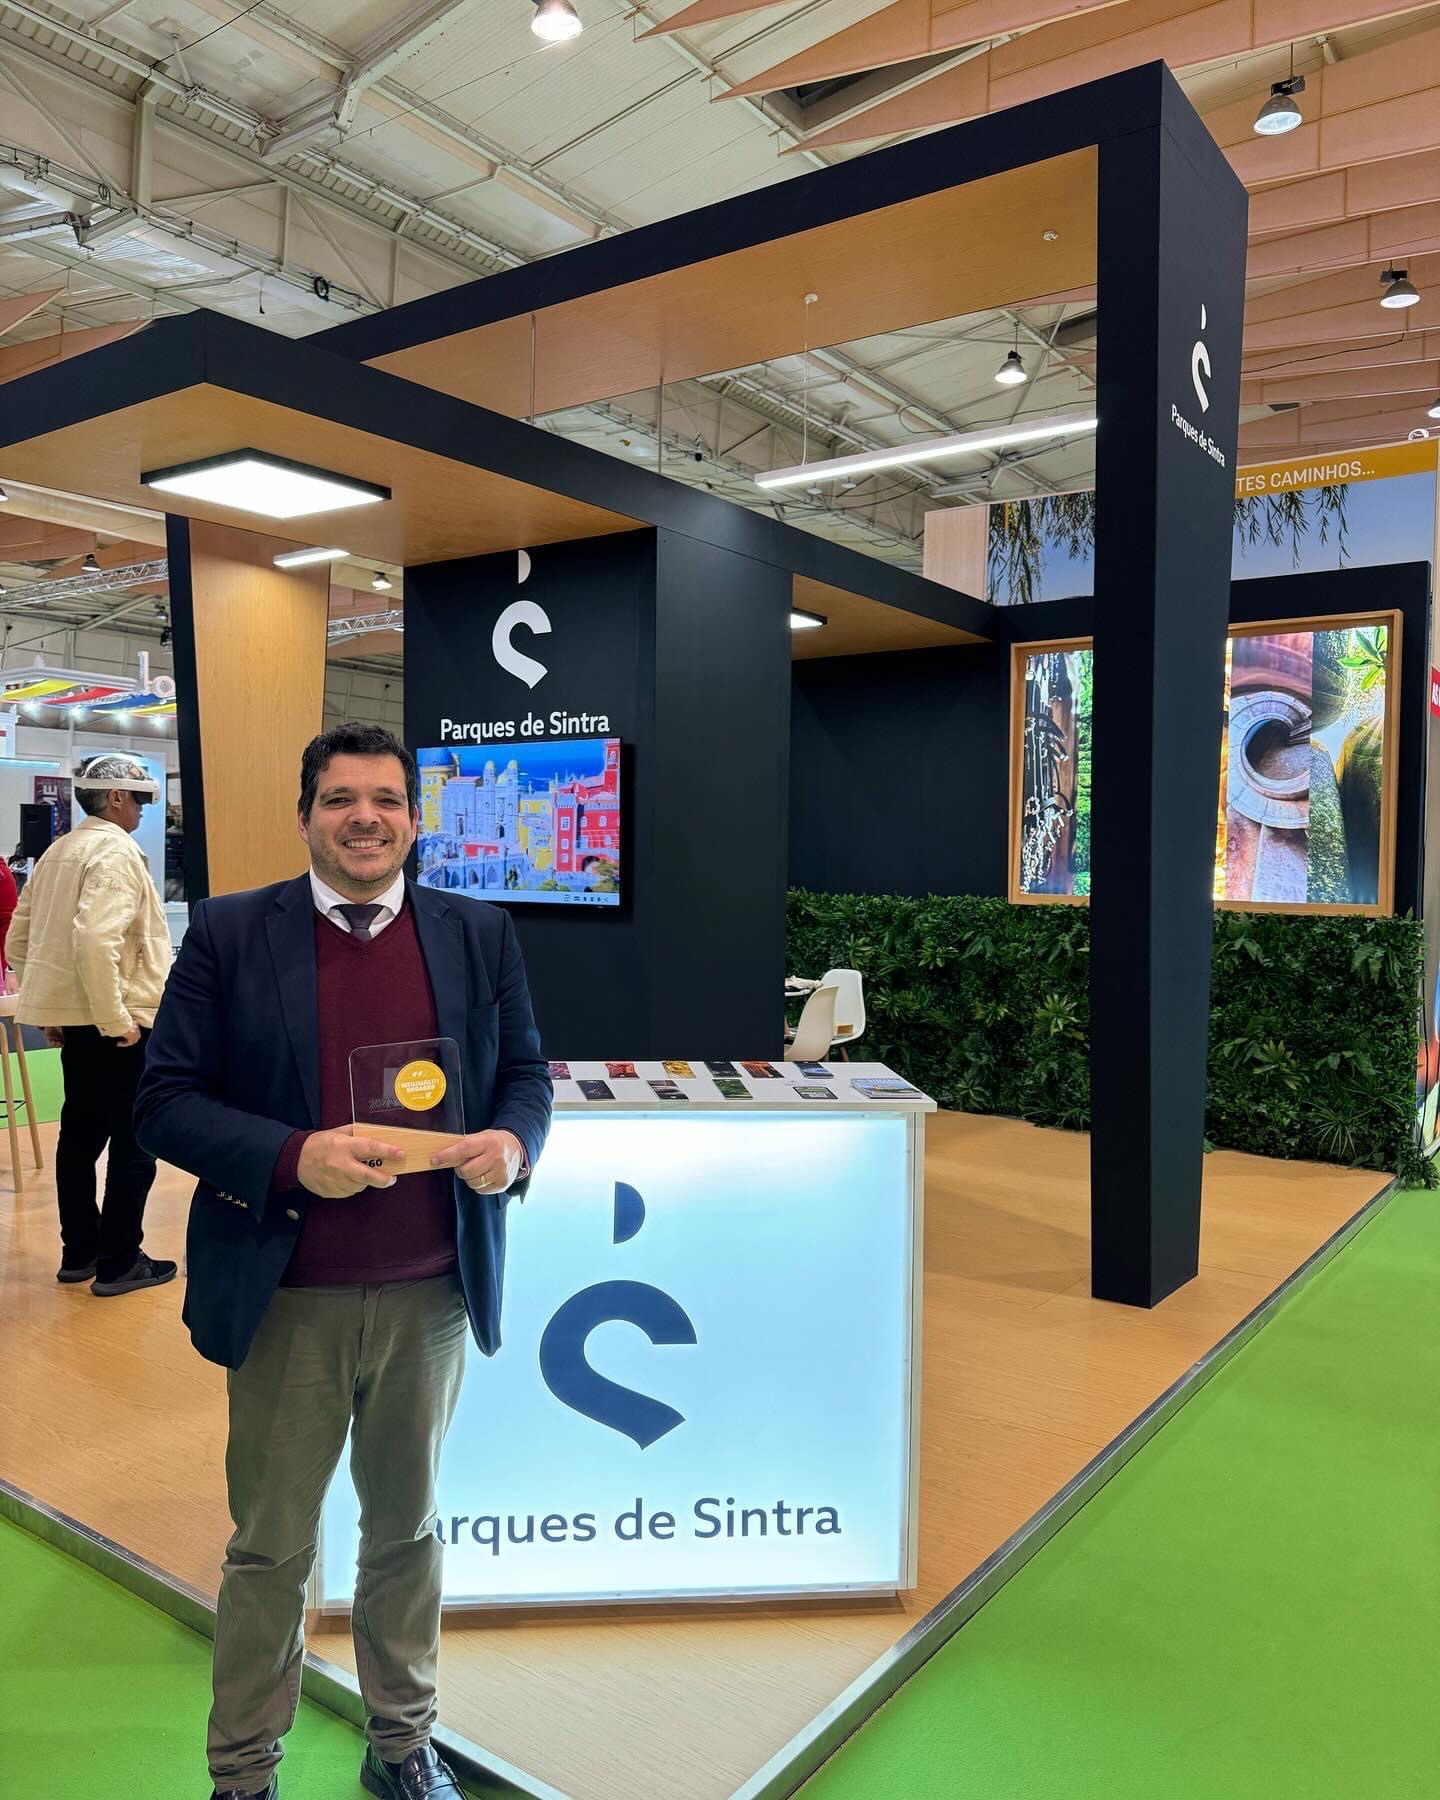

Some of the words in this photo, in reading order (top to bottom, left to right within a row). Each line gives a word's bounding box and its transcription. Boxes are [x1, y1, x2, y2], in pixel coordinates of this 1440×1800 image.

[1171, 403, 1199, 443] Parques
[1198, 429, 1208, 451] de
[1207, 437, 1226, 468] Sintra
[1270, 460, 1375, 488] CAMINHOS...
[440, 718, 516, 744] Parques
[520, 712, 545, 737] de
[549, 711, 610, 735] Sintra
[613, 1497, 676, 1541] de
[693, 1497, 843, 1539] Sintra
